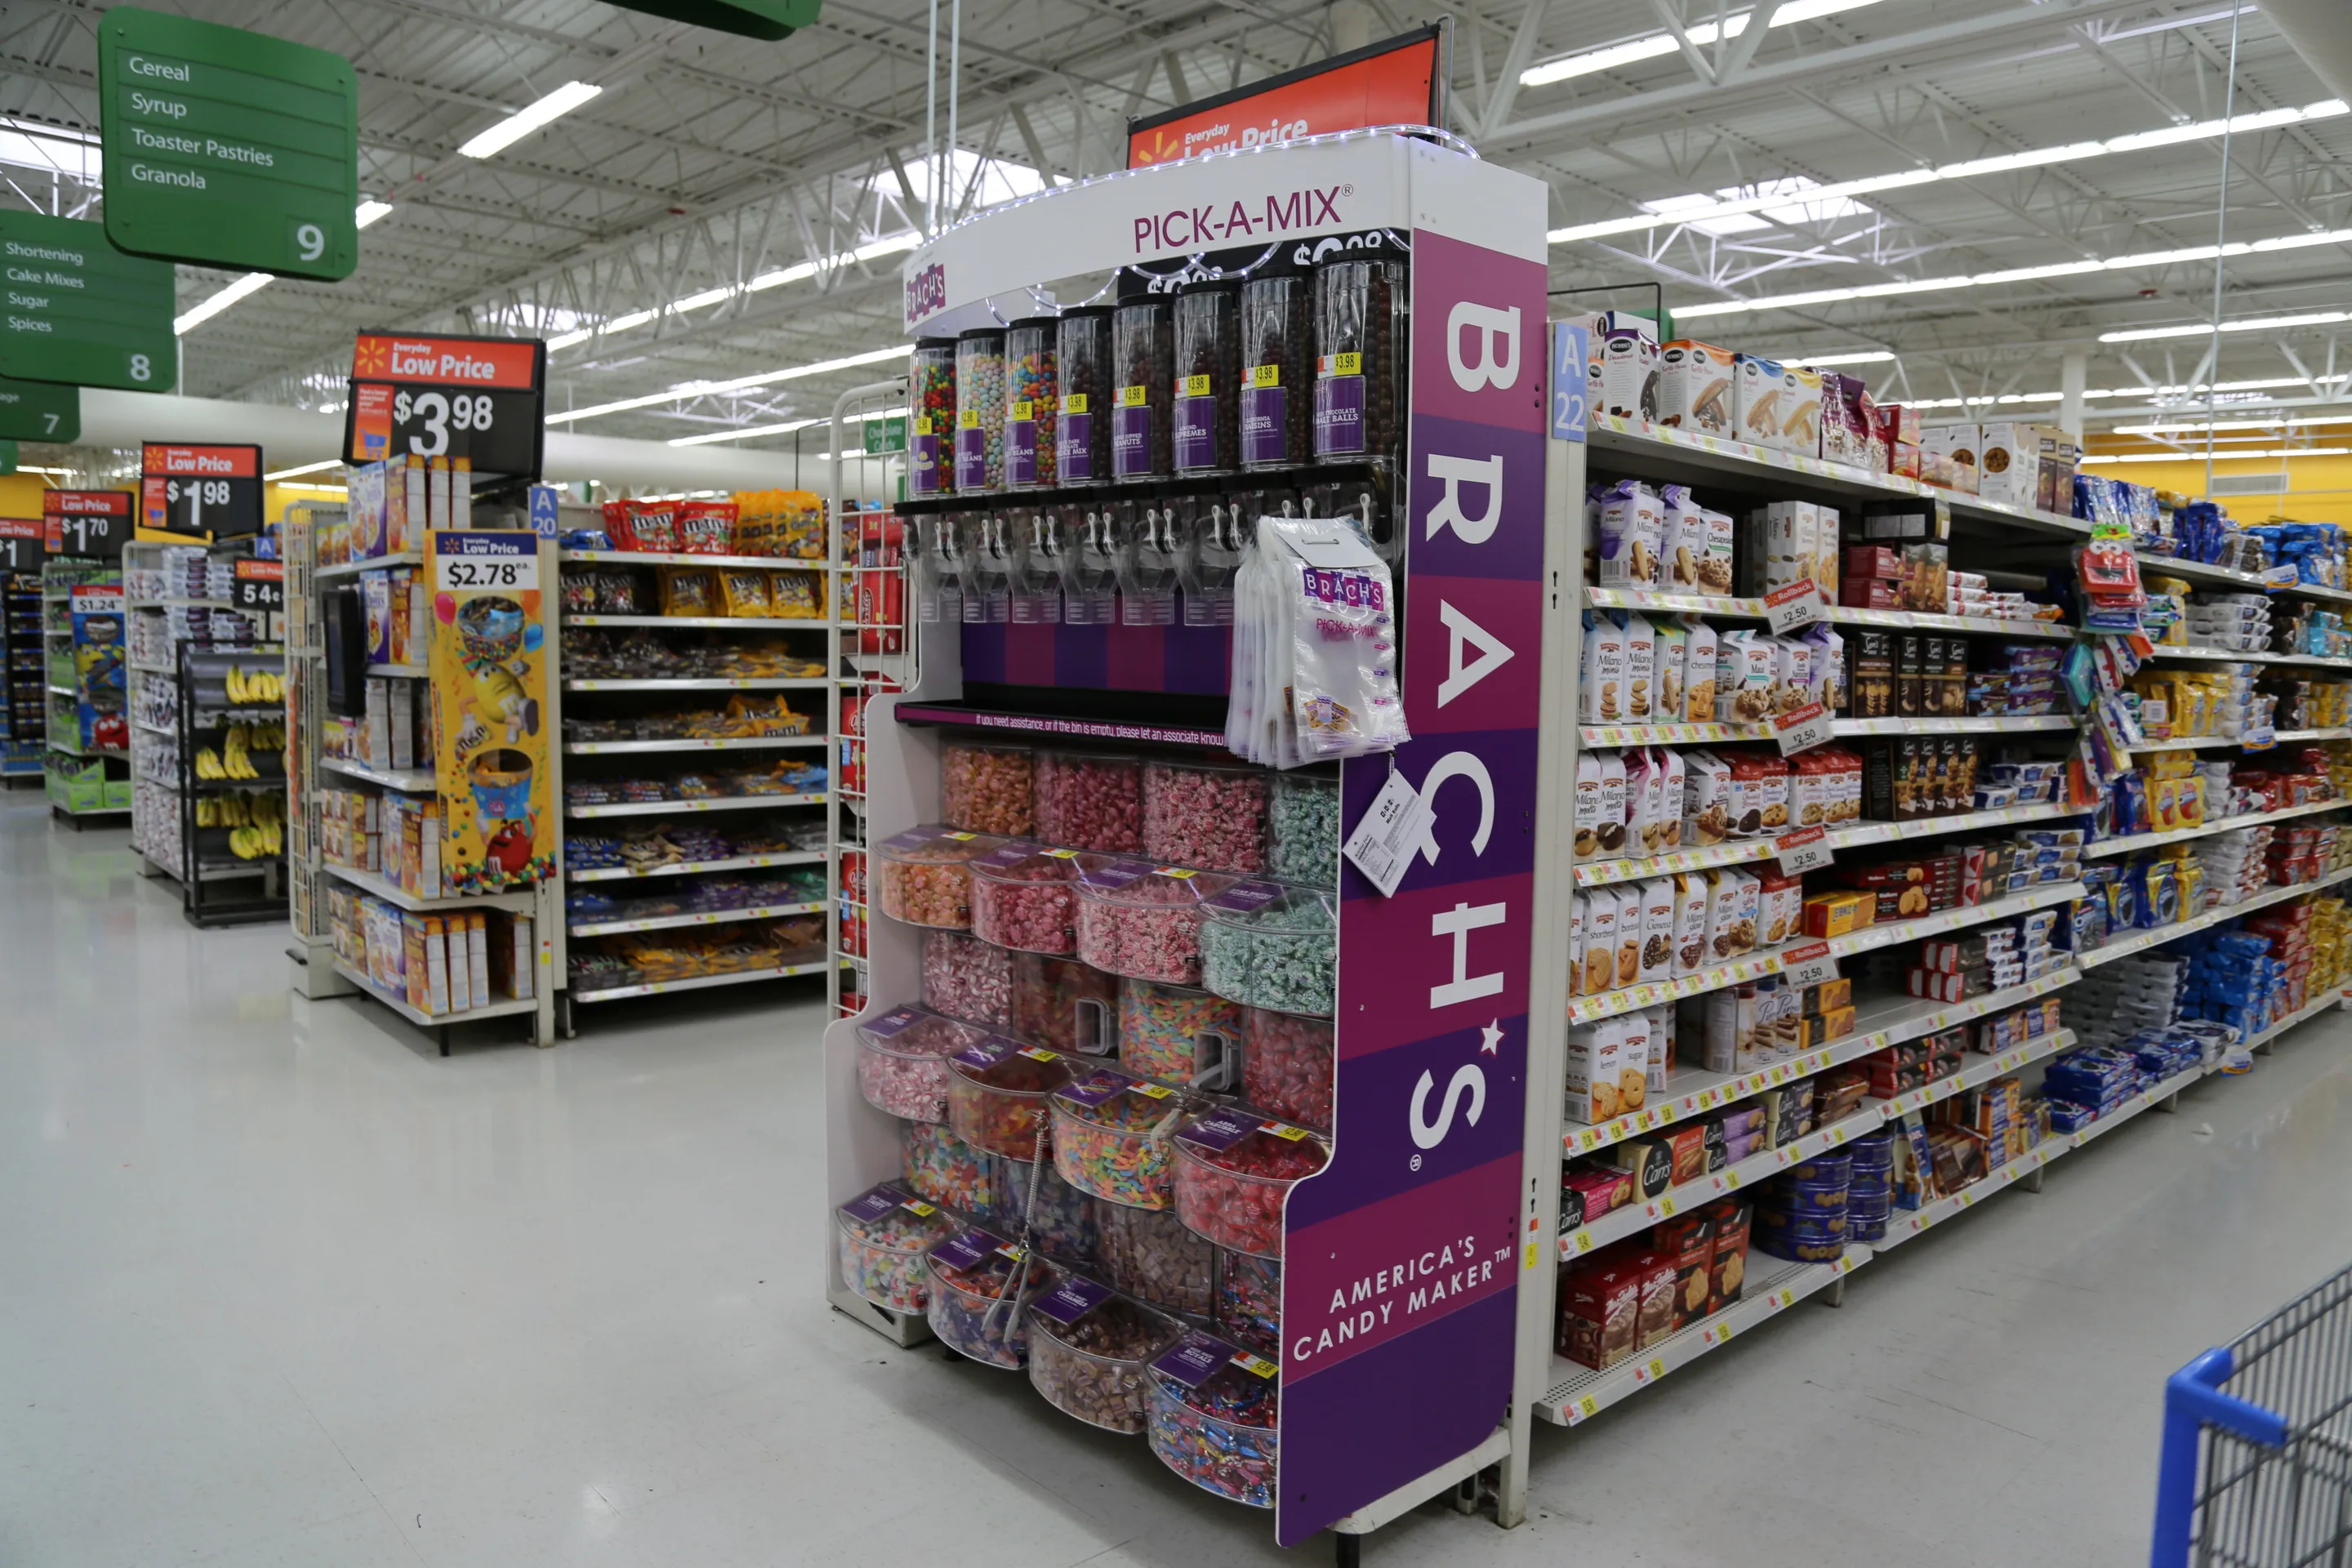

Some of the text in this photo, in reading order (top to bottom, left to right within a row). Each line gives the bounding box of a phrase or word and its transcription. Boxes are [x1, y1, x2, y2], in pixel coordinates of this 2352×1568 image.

[128, 56, 189, 82] Cereal
[131, 92, 187, 120] Syrup
[1184, 122, 1231, 145] Everyday
[1242, 118, 1309, 149] Price
[131, 128, 274, 167] Toaster Pastries
[131, 163, 207, 190] Granola
[296, 225, 325, 261] 9
[6, 242, 84, 266] Shortening
[7, 267, 85, 289] Cake Mixes
[8, 292, 50, 309] Sugar
[906, 274, 944, 311] BRACH'S
[8, 316, 53, 333] Spices
[393, 341, 432, 356] Everyday
[1561, 333, 1582, 379] A
[130, 353, 151, 382] 8
[391, 352, 496, 380] Low Price
[1335, 354, 1355, 368] $3.98
[1255, 367, 1273, 381] $3.98
[1187, 376, 1205, 390] $3.98
[1067, 395, 1082, 408] $3.98
[1125, 387, 1141, 400] $3.98
[1332, 412, 1359, 424] BALLS
[1555, 391, 1585, 434] 22
[43, 412, 60, 435] 7
[1012, 448, 1034, 457] BEANS
[167, 456, 233, 473] Low Price
[84, 499, 111, 513] Price
[535, 492, 553, 511] A
[0, 524, 19, 535] ow
[532, 516, 557, 536] 20
[463, 543, 520, 555] Low Price
[448, 562, 518, 588] $2.78
[1306, 572, 1382, 605] BRACH'S
[1777, 582, 1812, 601] Rollback
[1783, 606, 1807, 621] $2.50
[1596, 653, 1623, 667] Milano
[1626, 653, 1653, 666] Milano
[1786, 705, 1820, 723] Rollback
[981, 715, 994, 726] you
[994, 715, 1009, 728] need
[1009, 716, 1045, 732] assistance,
[1045, 721, 1053, 732] or
[1053, 719, 1058, 732] if
[1058, 720, 1071, 733] the
[1071, 721, 1083, 734] bin
[1083, 723, 1090, 734] is
[1116, 726, 1140, 739] please
[1140, 726, 1152, 740] let
[1152, 729, 1163, 741] an
[1163, 728, 1200, 743] associate
[1793, 728, 1816, 744] $2.50
[1599, 790, 1626, 804] Milano
[1788, 830, 1821, 844] Rollback
[1793, 851, 1817, 866] $2.50
[1794, 945, 1827, 960] Rollback
[1799, 967, 1823, 981] $2.50
[1643, 1160, 1673, 1186] Carr's
[1329, 1236, 1475, 1314] AMERICA'S
[1057, 1291, 1089, 1307] CARAMELS
[1293, 1300, 1393, 1362] CANDY
[1184, 1349, 1214, 1365] ROYALS
